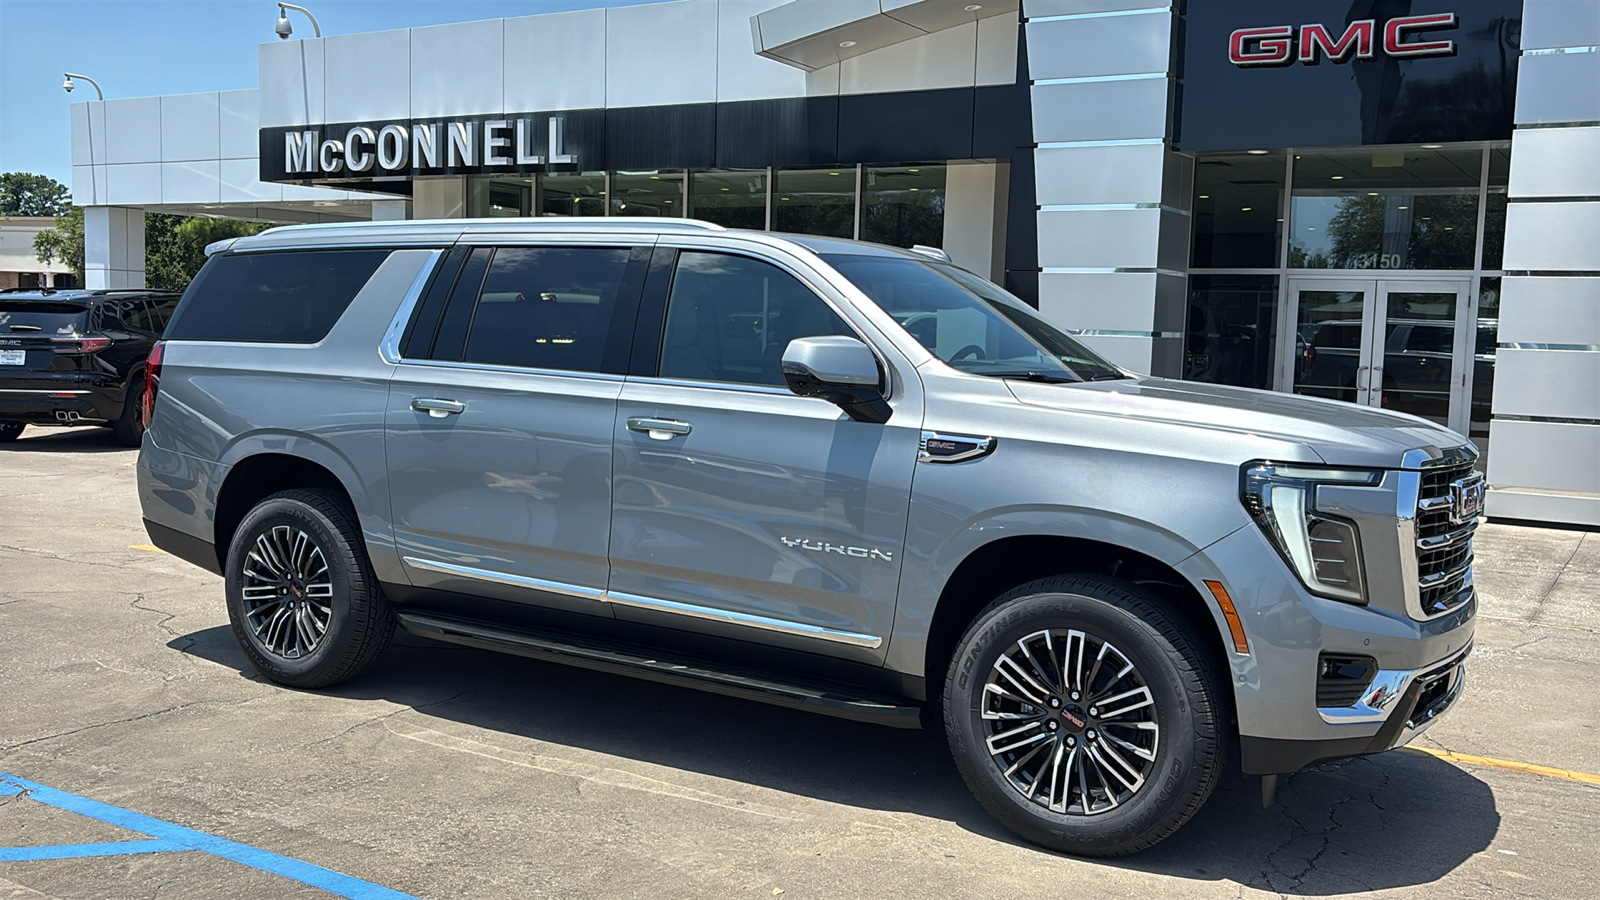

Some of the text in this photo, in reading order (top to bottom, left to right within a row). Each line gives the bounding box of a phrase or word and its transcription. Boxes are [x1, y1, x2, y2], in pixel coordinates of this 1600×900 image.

[1228, 12, 1456, 65] GMC
[285, 117, 578, 173] McCONNELL
[1359, 253, 1401, 269] 3150
[928, 440, 956, 450] GMC
[780, 536, 893, 562] YUKON
[958, 602, 1081, 692] CONTINENTAL
